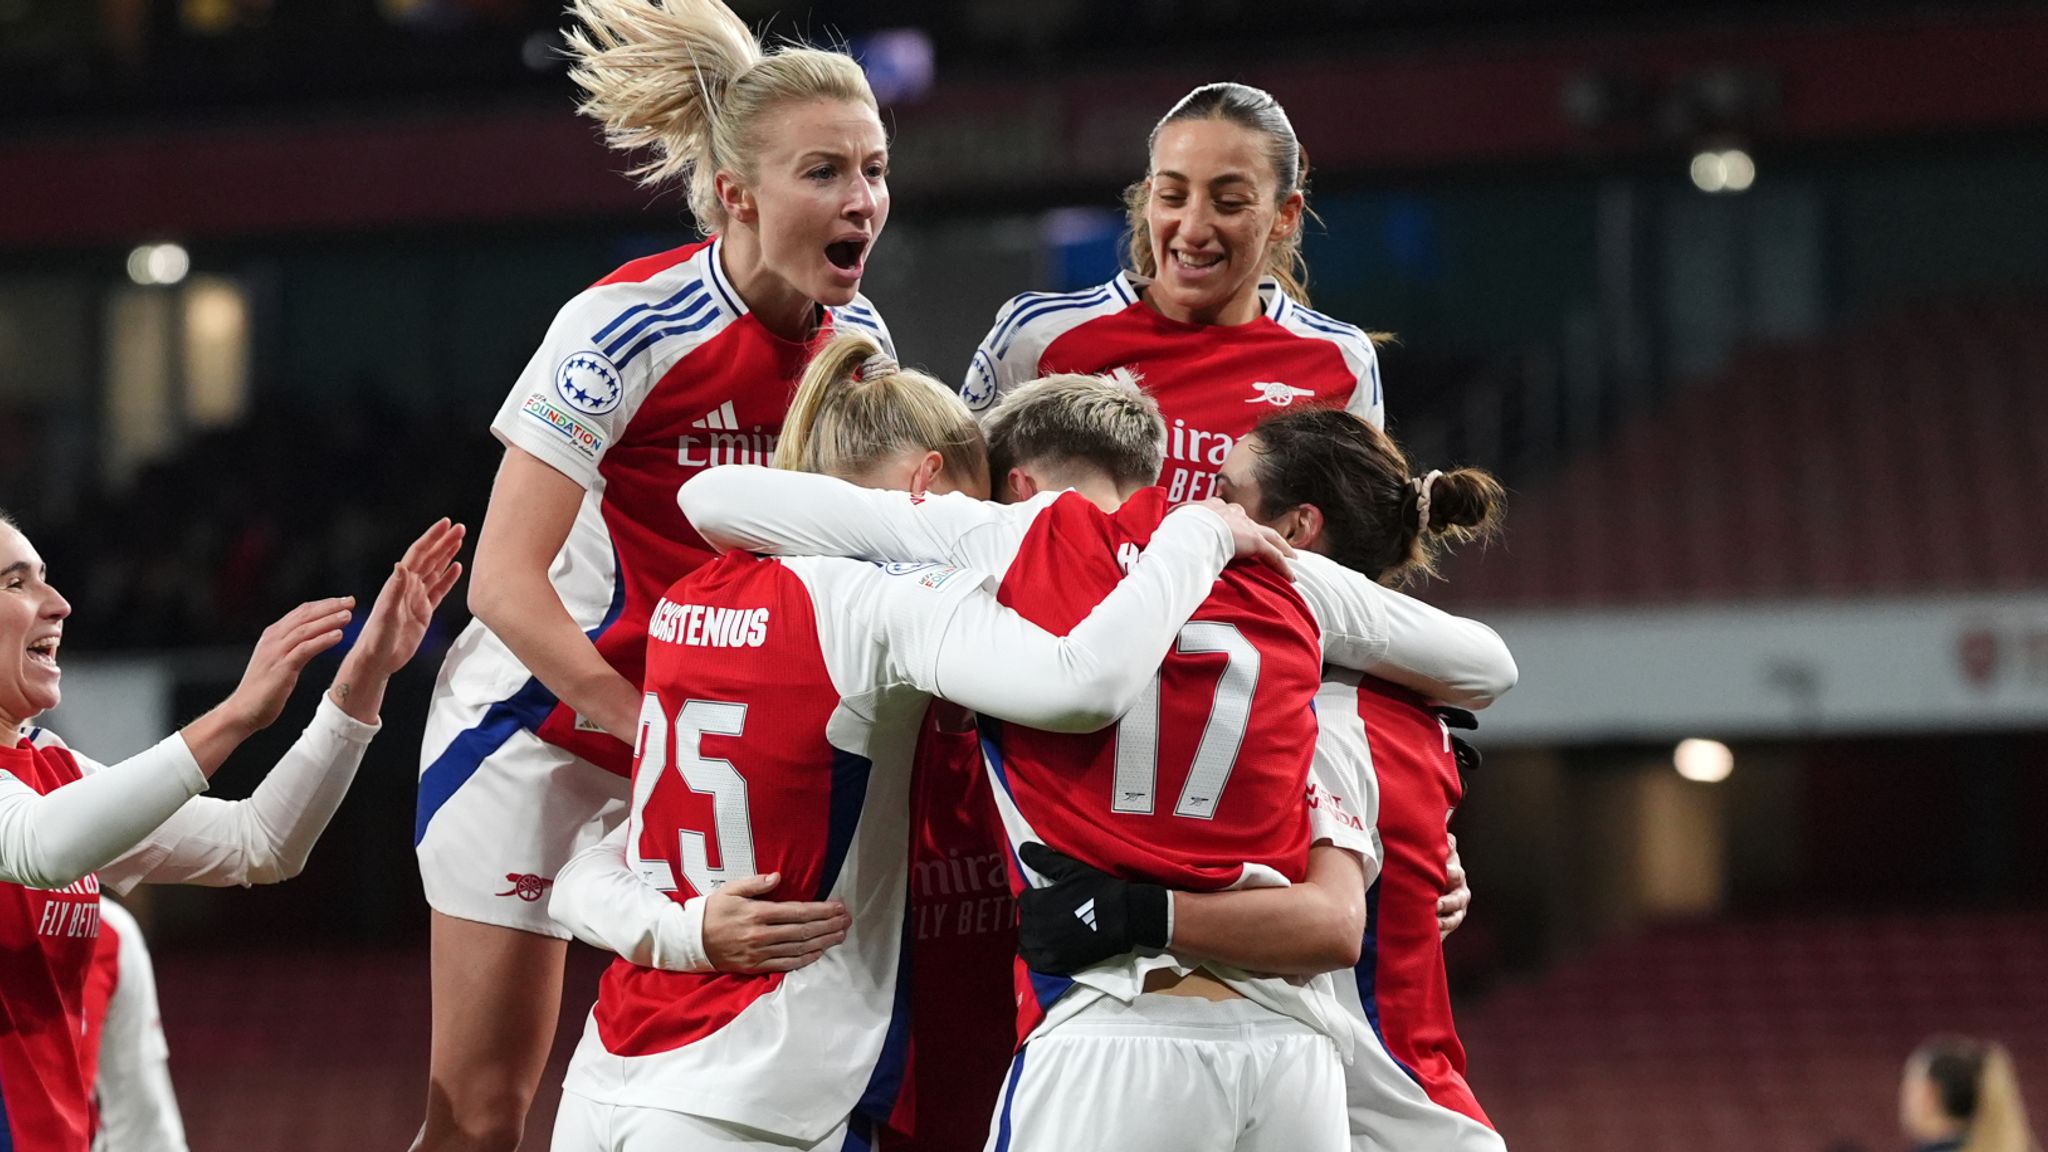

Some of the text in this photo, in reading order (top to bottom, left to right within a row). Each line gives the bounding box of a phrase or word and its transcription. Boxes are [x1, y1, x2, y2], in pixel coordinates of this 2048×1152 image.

[524, 398, 602, 451] FOUNDATION
[1163, 419, 1247, 465] ira
[1111, 621, 1261, 820] 17
[626, 692, 757, 897] 25
[38, 900, 70, 936] FLY
[912, 903, 947, 940] LY
